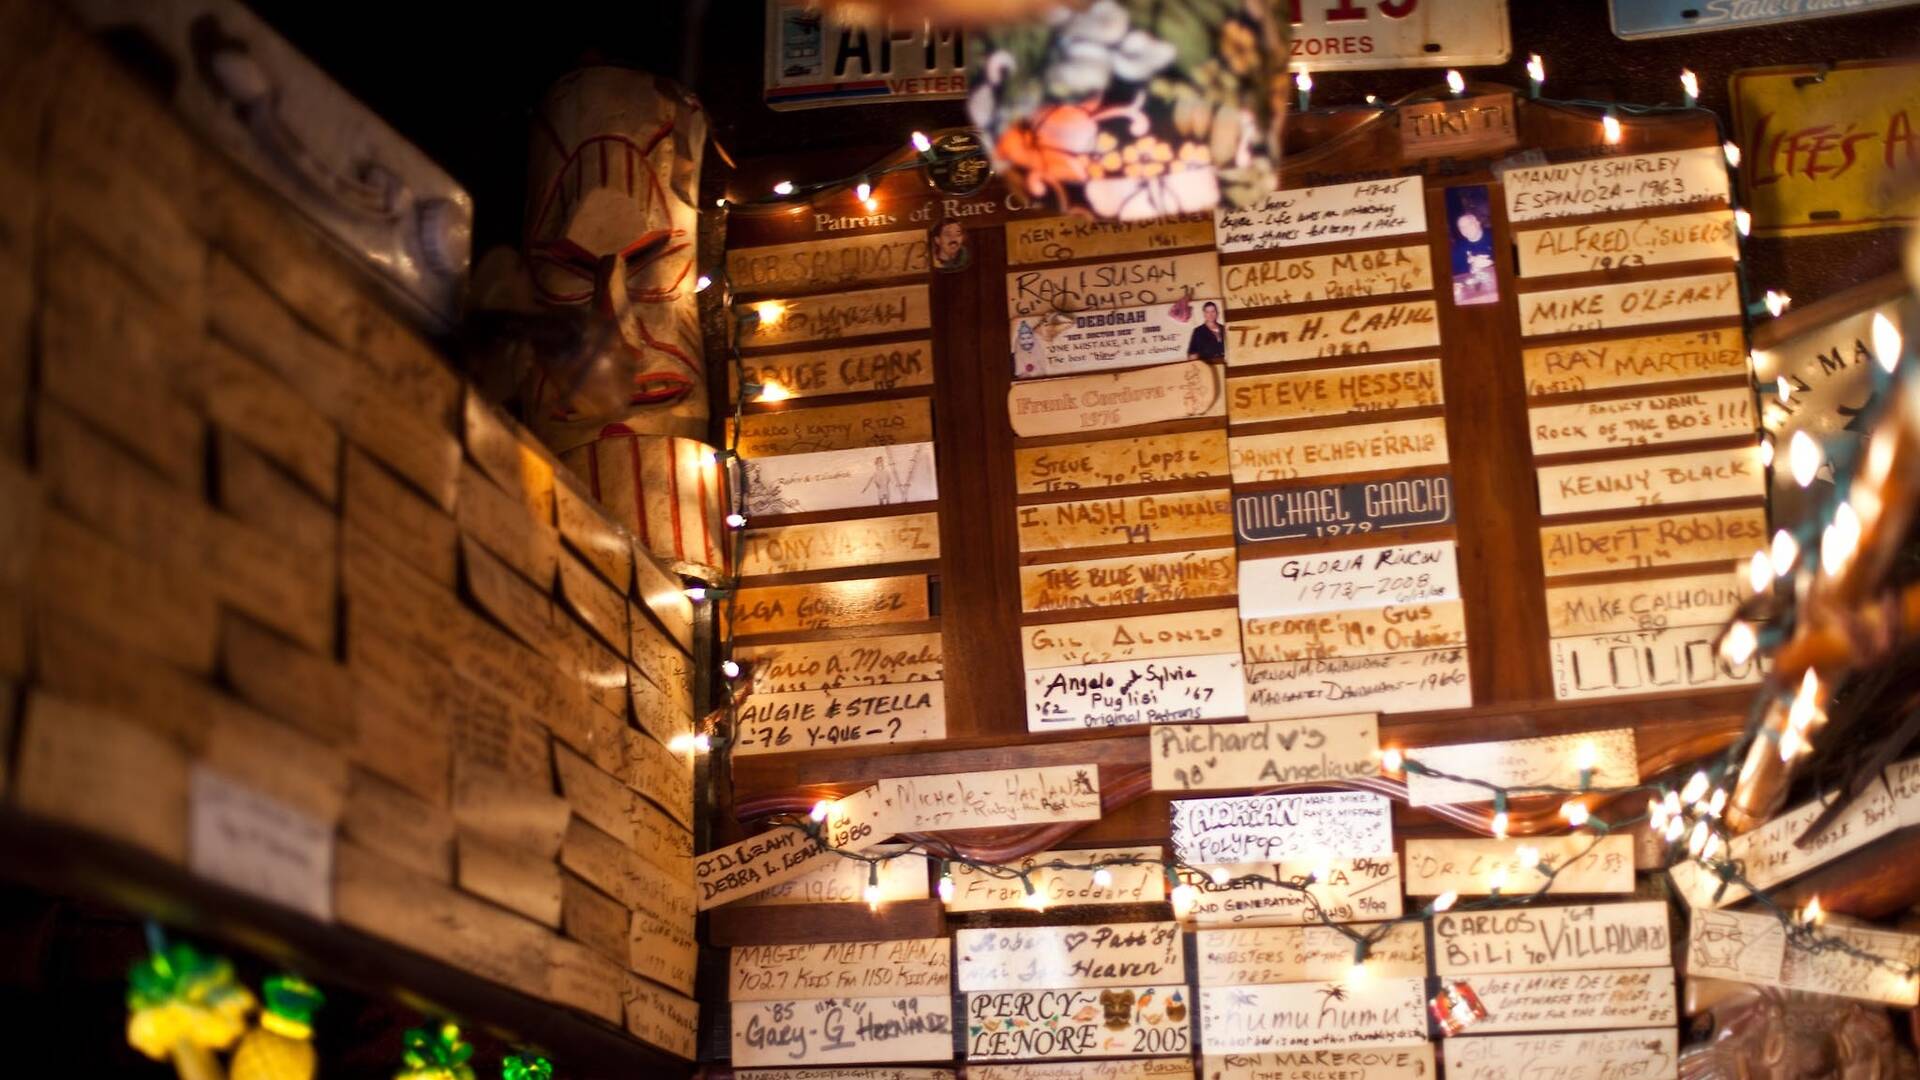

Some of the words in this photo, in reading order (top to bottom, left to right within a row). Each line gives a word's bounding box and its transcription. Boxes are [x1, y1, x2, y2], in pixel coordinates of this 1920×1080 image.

[1290, 36, 1374, 56] ZORES
[890, 76, 966, 93] VETER
[1603, 157, 1681, 178] SHIRLEY
[815, 213, 897, 232] Patrons
[909, 206, 929, 222] of
[944, 198, 996, 218] Rare
[1536, 226, 1629, 255] ALFRED
[1094, 261, 1178, 288] SUSAN
[1226, 260, 1315, 292] CARLOS
[1332, 250, 1412, 276] MORA
[1529, 294, 1604, 324] MIKE
[839, 349, 922, 386] CLARK
[1545, 347, 1608, 374] RAY
[1615, 350, 1743, 376] MARTINEZ
[1234, 379, 1328, 410] STEVE
[1340, 371, 1434, 400] HESSEN
[1559, 470, 1650, 499] KENNY
[1660, 461, 1751, 485] BLACK
[1057, 499, 1126, 526] NASH
[1236, 487, 1350, 531] MICHAEL
[1364, 477, 1450, 518] GARCIA
[1316, 521, 1373, 538] 1979
[1658, 517, 1762, 545] Robles
[1087, 564, 1137, 588] BLUE
[1281, 554, 1364, 581] GLORIA
[1045, 672, 1114, 697] Angelo
[1146, 664, 1198, 691] Sylvia
[1091, 690, 1158, 712] Puglisi
[1183, 687, 1214, 702] '67
[738, 702, 815, 725] AUGIE
[1084, 711, 1141, 729] Original
[1153, 723, 1269, 758] Richard
[1259, 753, 1378, 782] Angelique
[1189, 797, 1303, 838] ADRIAN
[699, 868, 760, 900] DEBRA
[784, 838, 829, 870] LEAH
[1049, 873, 1148, 900] Goddard
[1224, 893, 1307, 913] GENERATION
[1437, 913, 1536, 938] CARLOS
[824, 941, 886, 965] MATT
[970, 1024, 1099, 1058] LENORE
[1132, 1026, 1190, 1053] 2005
[1223, 1052, 1263, 1071] RON
